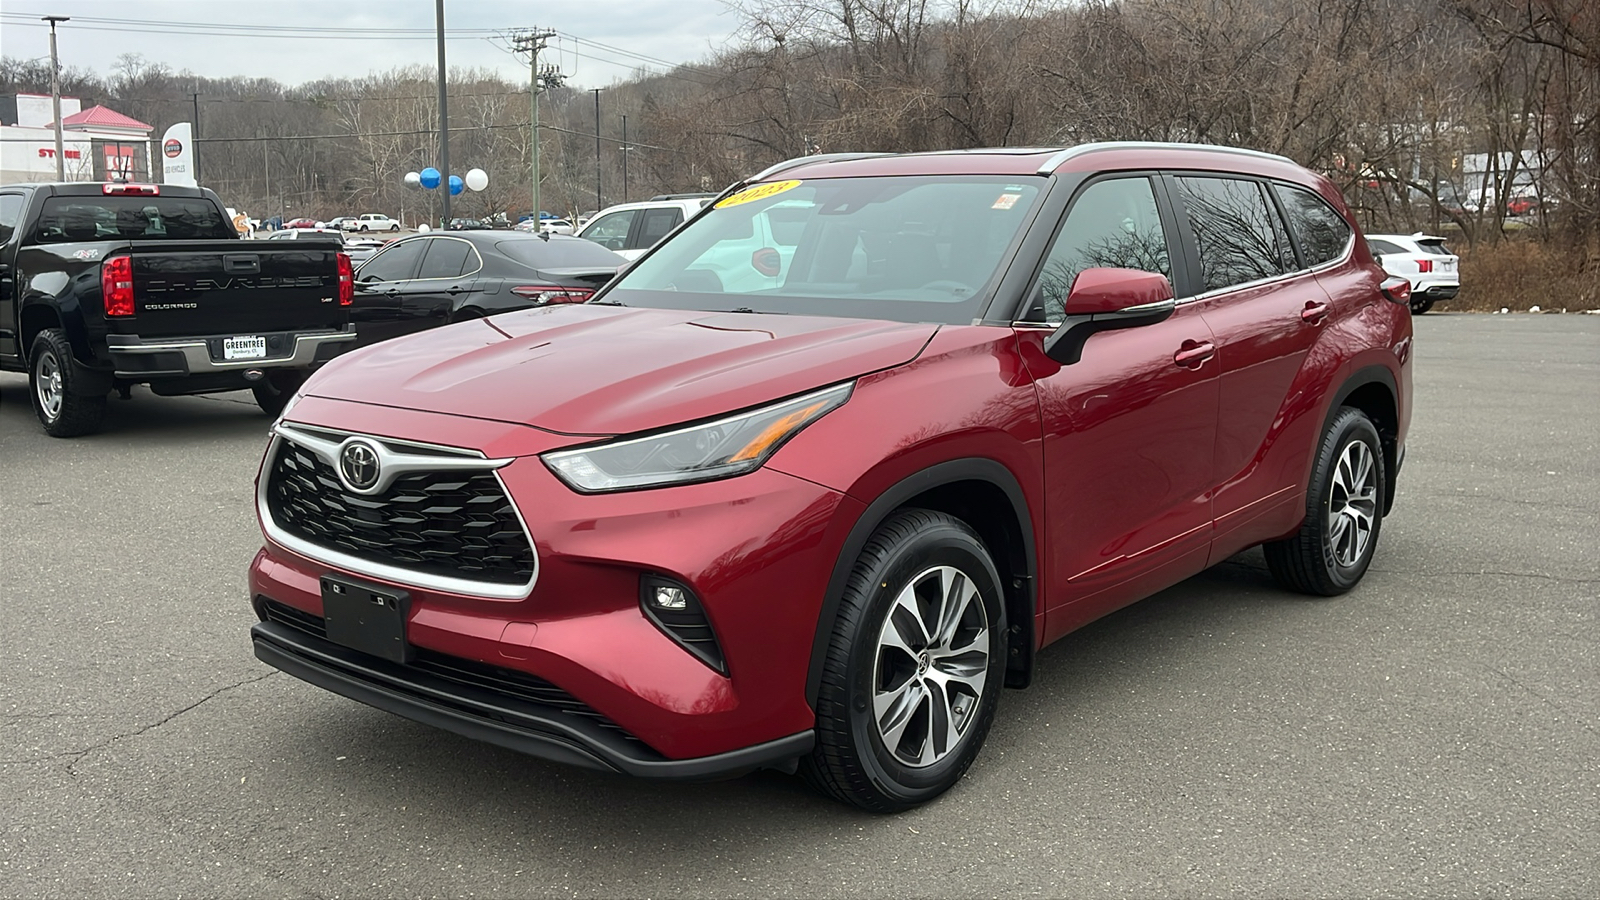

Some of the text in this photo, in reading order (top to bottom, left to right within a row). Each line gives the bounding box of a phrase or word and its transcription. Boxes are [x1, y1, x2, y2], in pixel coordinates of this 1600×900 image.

[38, 148, 81, 159] STNE
[726, 181, 790, 205] 2023
[144, 302, 198, 311] COLORADO
[226, 340, 264, 349] GREENTREE
